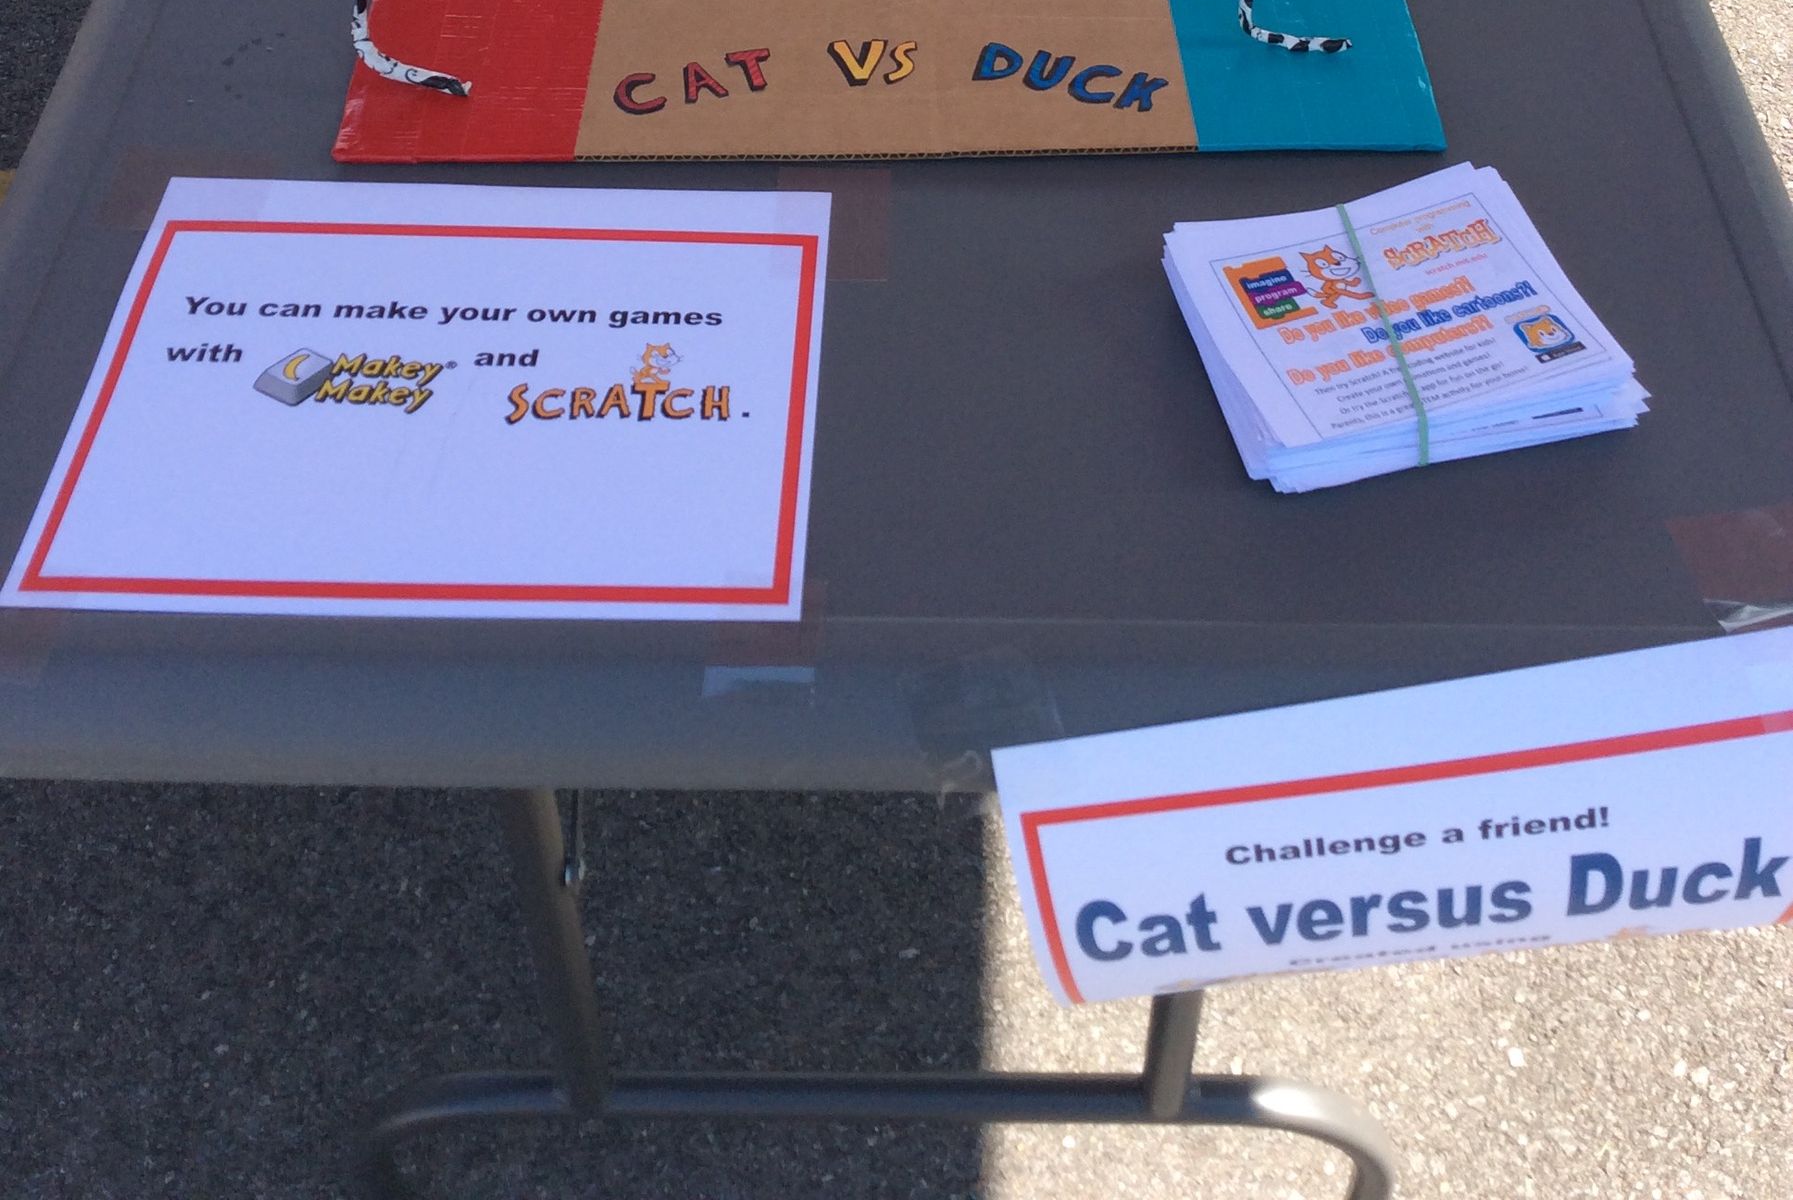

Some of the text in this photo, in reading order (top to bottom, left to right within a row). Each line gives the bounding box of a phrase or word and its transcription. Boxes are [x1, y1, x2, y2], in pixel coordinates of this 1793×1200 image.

[613, 39, 1169, 116] CAT VS DUCK
[1246, 274, 1288, 290] imagine
[1254, 287, 1298, 304] program
[185, 296, 723, 329] You can make your own games
[1263, 303, 1293, 317] share
[1277, 327, 1305, 344] Do
[1303, 318, 1337, 341] you
[1332, 310, 1367, 329] like
[1361, 326, 1391, 344] Do
[1392, 317, 1421, 340] you
[1417, 308, 1452, 328] like
[166, 342, 243, 364] with
[474, 347, 539, 369] and
[1286, 368, 1316, 386] Do
[1315, 359, 1351, 382] you
[1348, 350, 1386, 368] like
[315, 378, 433, 415] Makey
[1224, 806, 1610, 867] Challenge a friend!
[1075, 836, 1791, 962] Cat versus Duck
